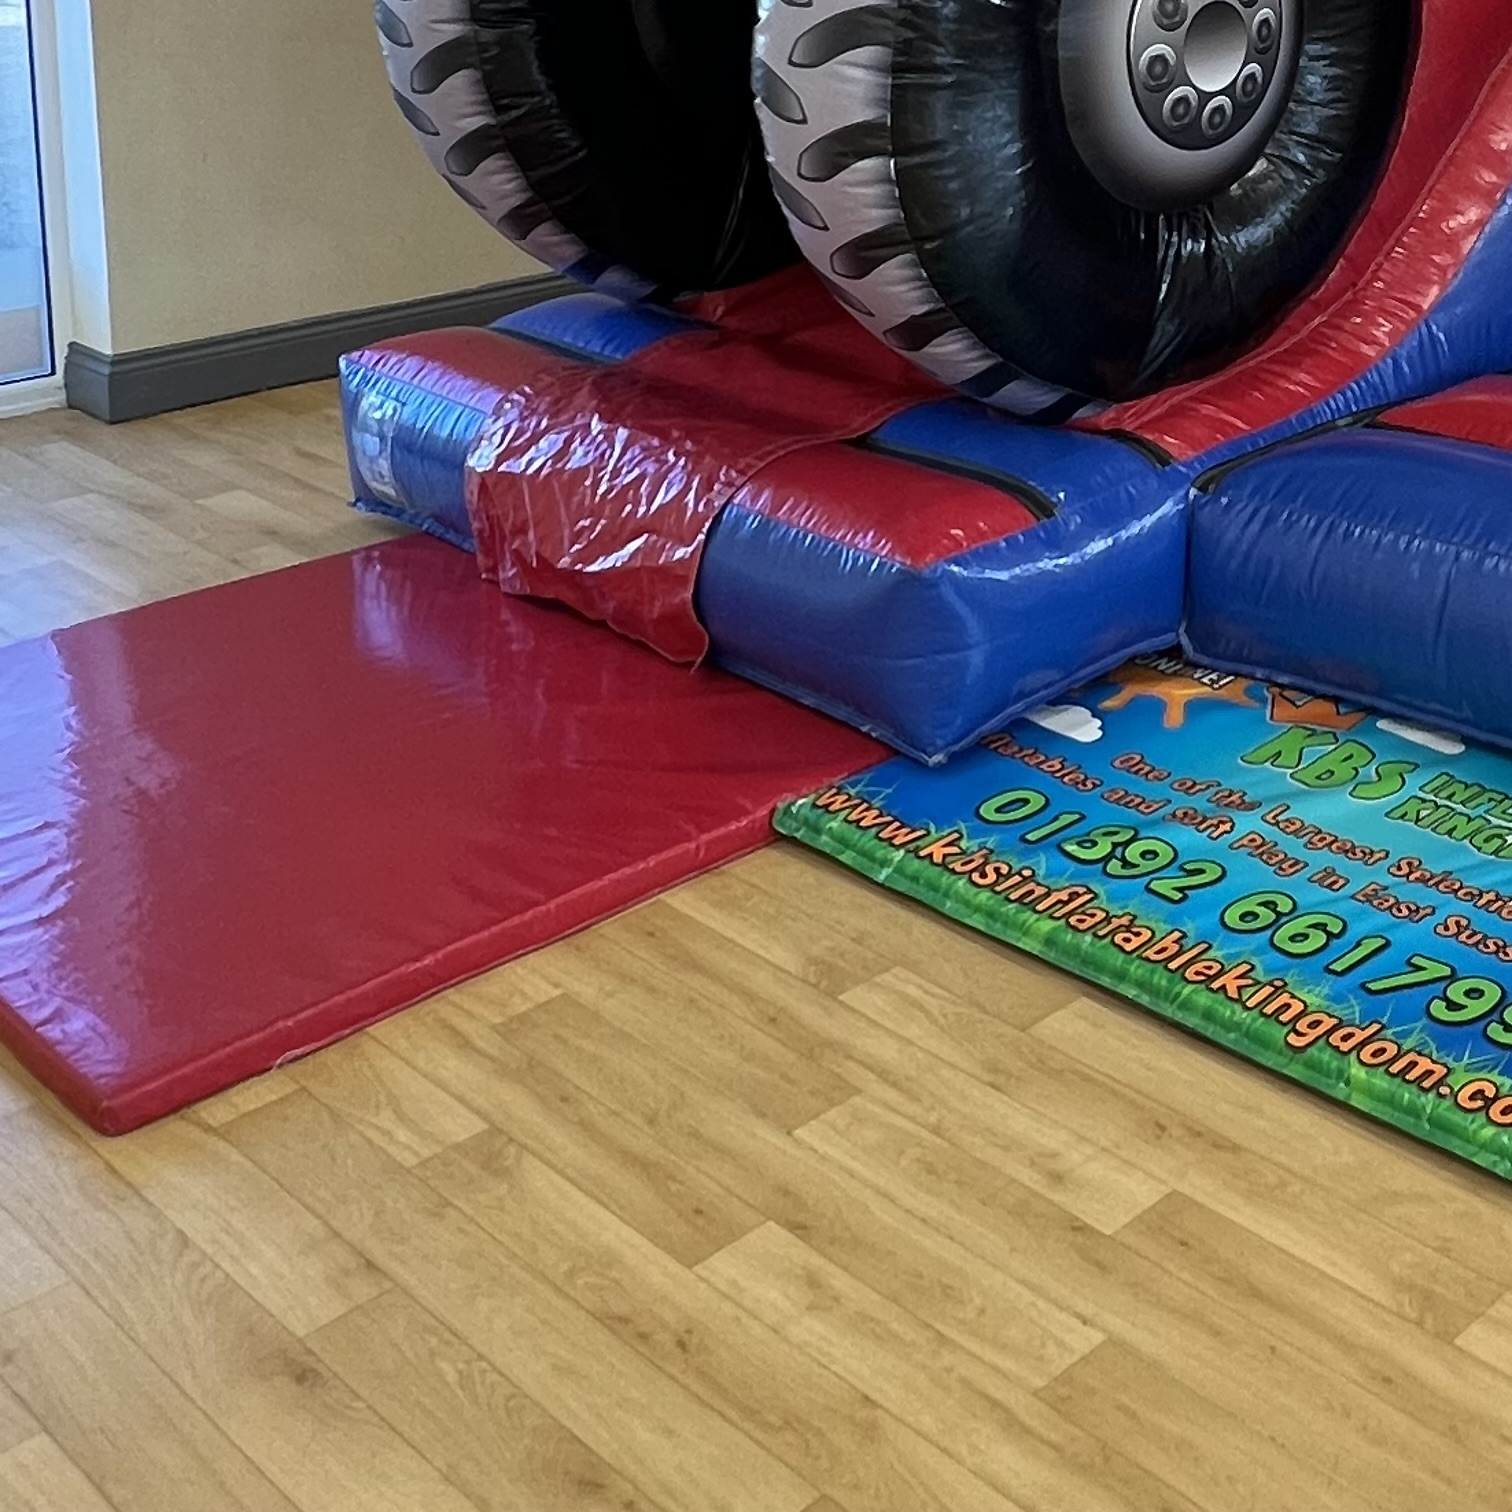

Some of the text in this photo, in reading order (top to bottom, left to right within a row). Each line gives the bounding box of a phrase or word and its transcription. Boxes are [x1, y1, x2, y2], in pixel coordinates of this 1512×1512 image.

[1111, 752, 1171, 781] One
[1170, 778, 1221, 797] of
[1207, 788, 1262, 811] the
[1261, 803, 1389, 866] Largest
[1240, 725, 1420, 800] KBS
[976, 787, 1227, 904] 01892
[981, 733, 1102, 791] flatables
[1101, 788, 1172, 815] and
[1164, 806, 1236, 840] Soft
[1229, 831, 1309, 877] Play
[1308, 866, 1350, 891] in
[1352, 882, 1438, 924] East
